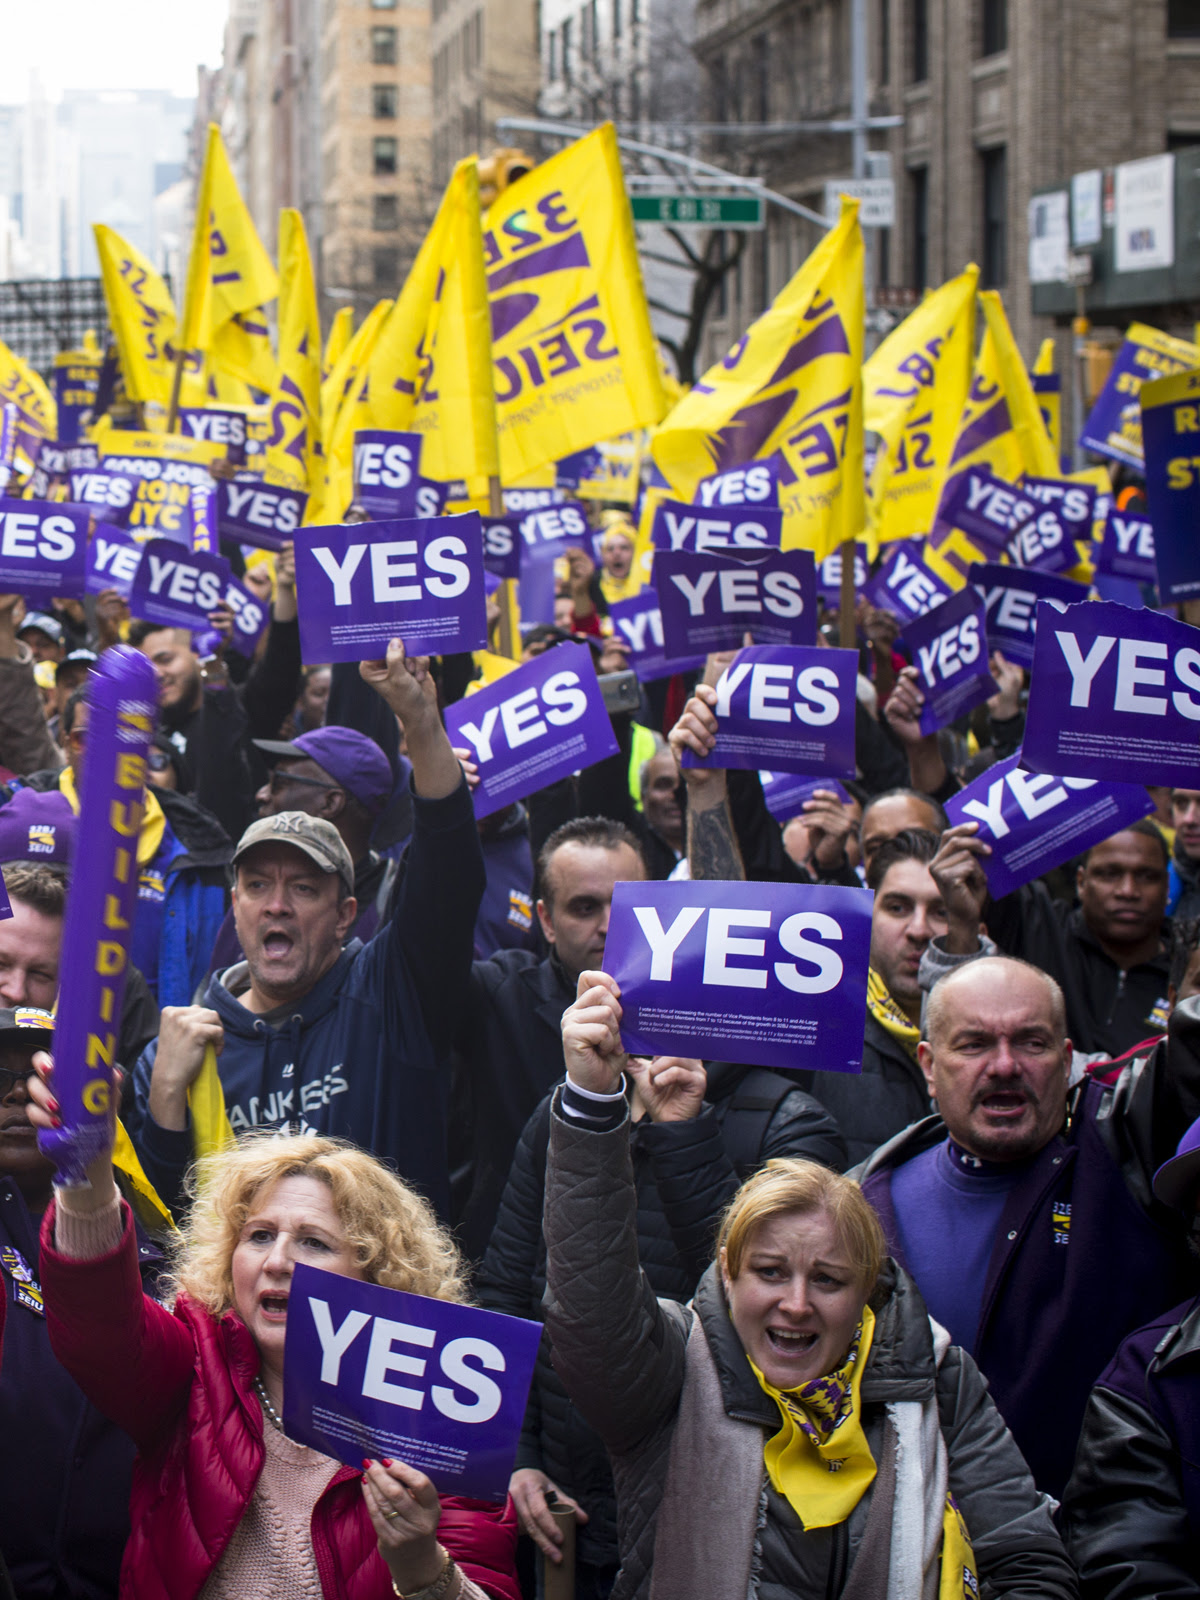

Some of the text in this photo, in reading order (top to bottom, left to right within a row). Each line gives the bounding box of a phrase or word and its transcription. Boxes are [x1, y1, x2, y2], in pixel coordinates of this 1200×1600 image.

[186, 414, 246, 445] YES
[71, 473, 133, 508] YES
[226, 484, 300, 533] YES
[701, 468, 770, 506] YES
[519, 507, 586, 545] YES
[664, 512, 768, 551] YES
[1007, 512, 1063, 568] YES
[1113, 517, 1156, 557] YE
[94, 538, 143, 582] YE
[148, 555, 221, 610] YES
[310, 536, 471, 606] YES
[225, 583, 263, 634] ES
[670, 569, 803, 618] YES
[918, 613, 980, 688] YES
[1054, 630, 1200, 721] YES
[459, 670, 588, 764] YES
[716, 663, 840, 727] YES
[961, 767, 1099, 840] YE
[28, 844, 55, 854] SEIU
[81, 752, 148, 1117] BUILDING
[632, 906, 844, 995] YES
[227, 1063, 349, 1130] ANKEES
[17, 1292, 44, 1312] SEIU
[307, 1296, 506, 1424] YES
